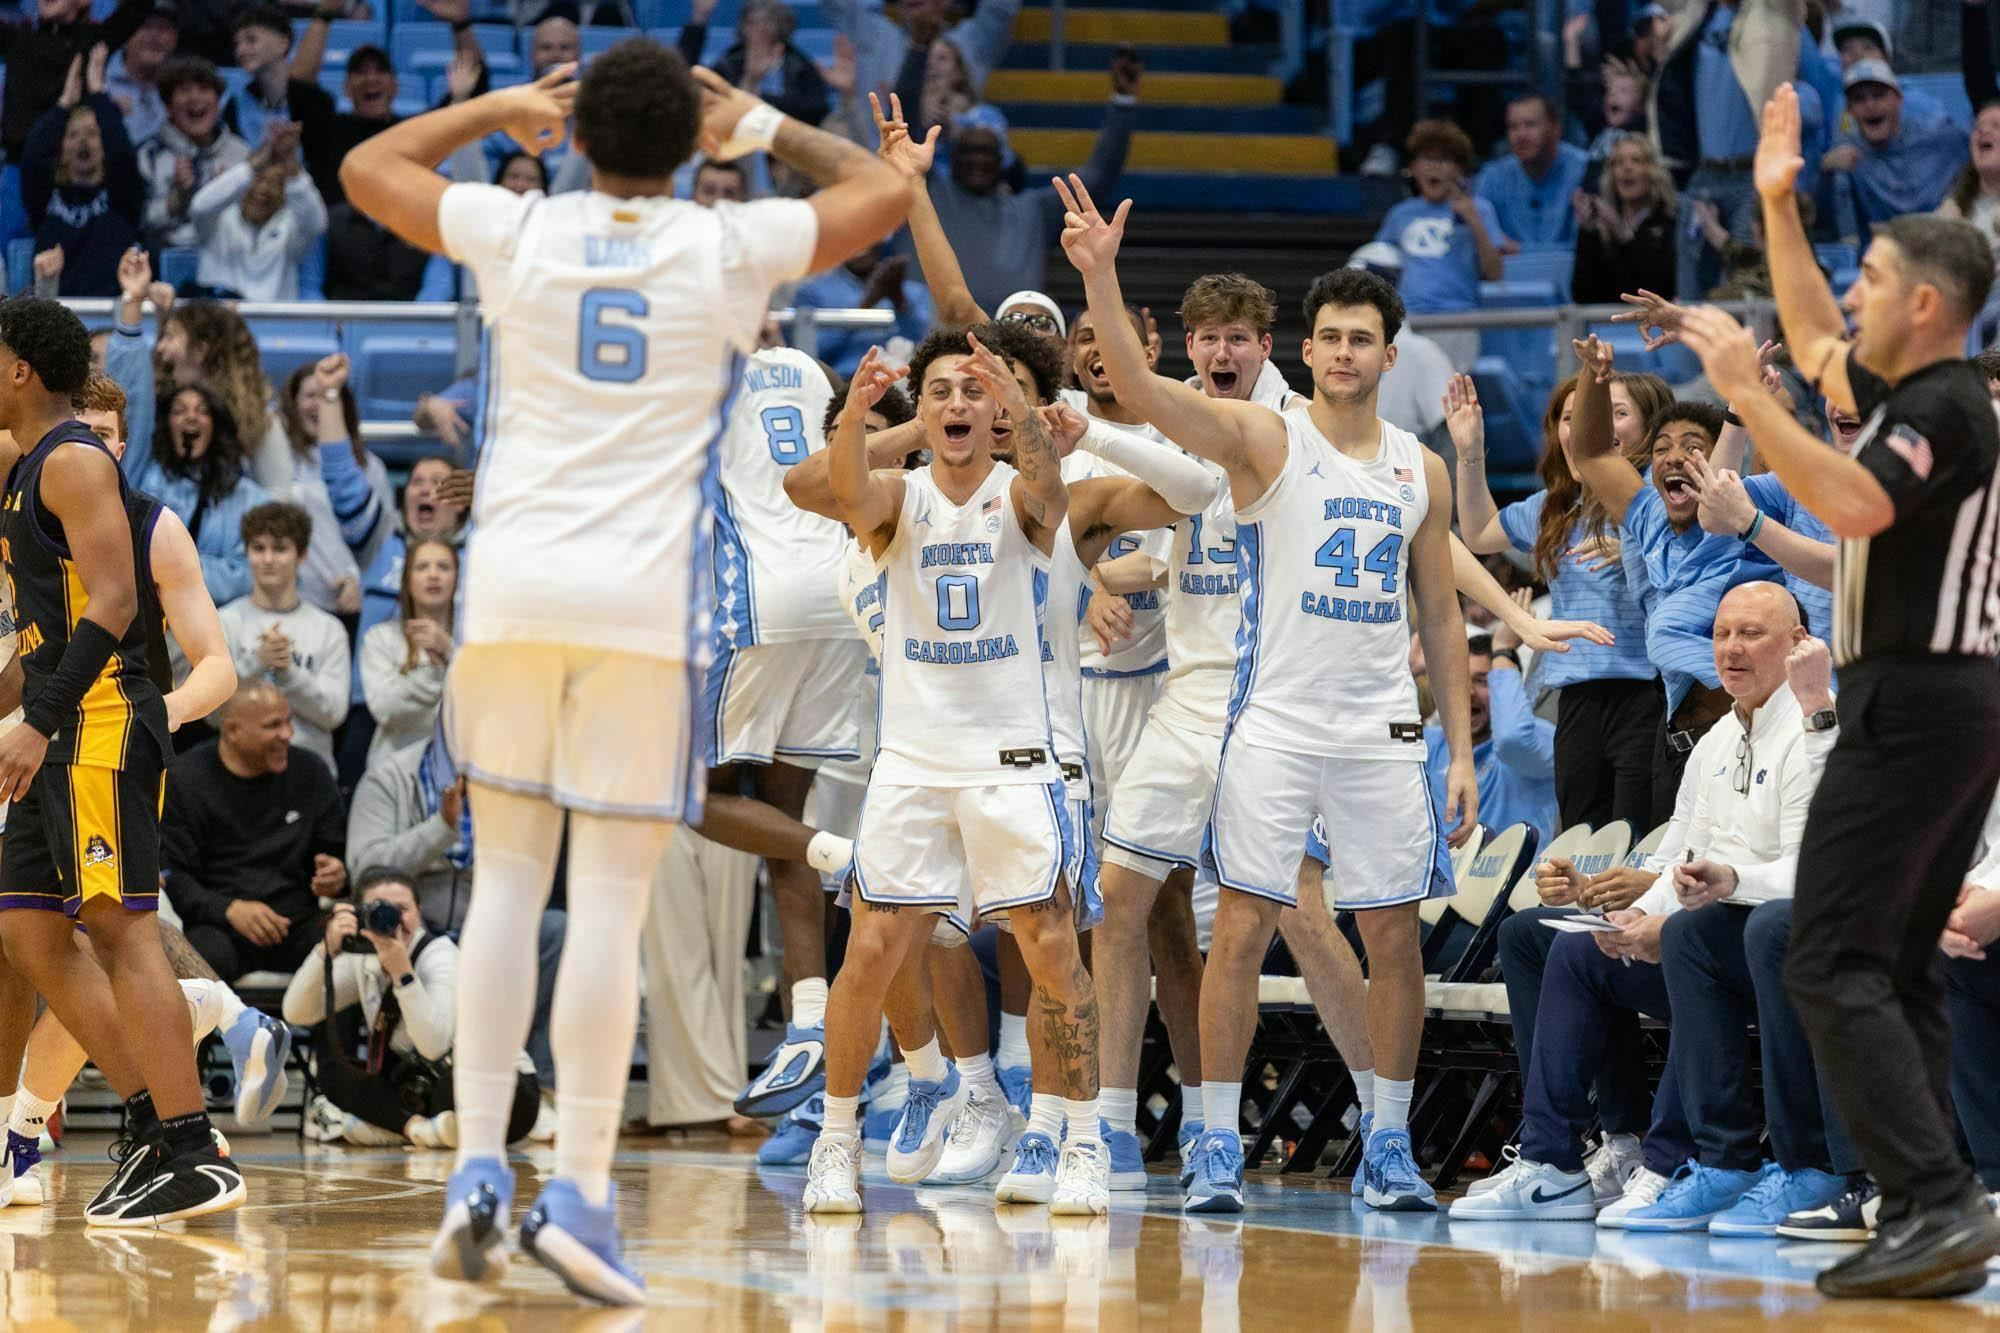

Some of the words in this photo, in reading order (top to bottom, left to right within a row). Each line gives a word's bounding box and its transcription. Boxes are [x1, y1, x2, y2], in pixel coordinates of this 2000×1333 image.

[577, 285, 650, 382] 6
[744, 366, 802, 392] WILSON
[761, 405, 810, 465] 8
[1324, 497, 1402, 529] NORTH
[921, 543, 994, 568] NORTH
[1315, 527, 1403, 593] 44
[1180, 571, 1240, 595] AROLI
[936, 574, 980, 631] 0
[1301, 591, 1401, 623] CAROLINA
[905, 634, 1019, 664] CAROLINA
